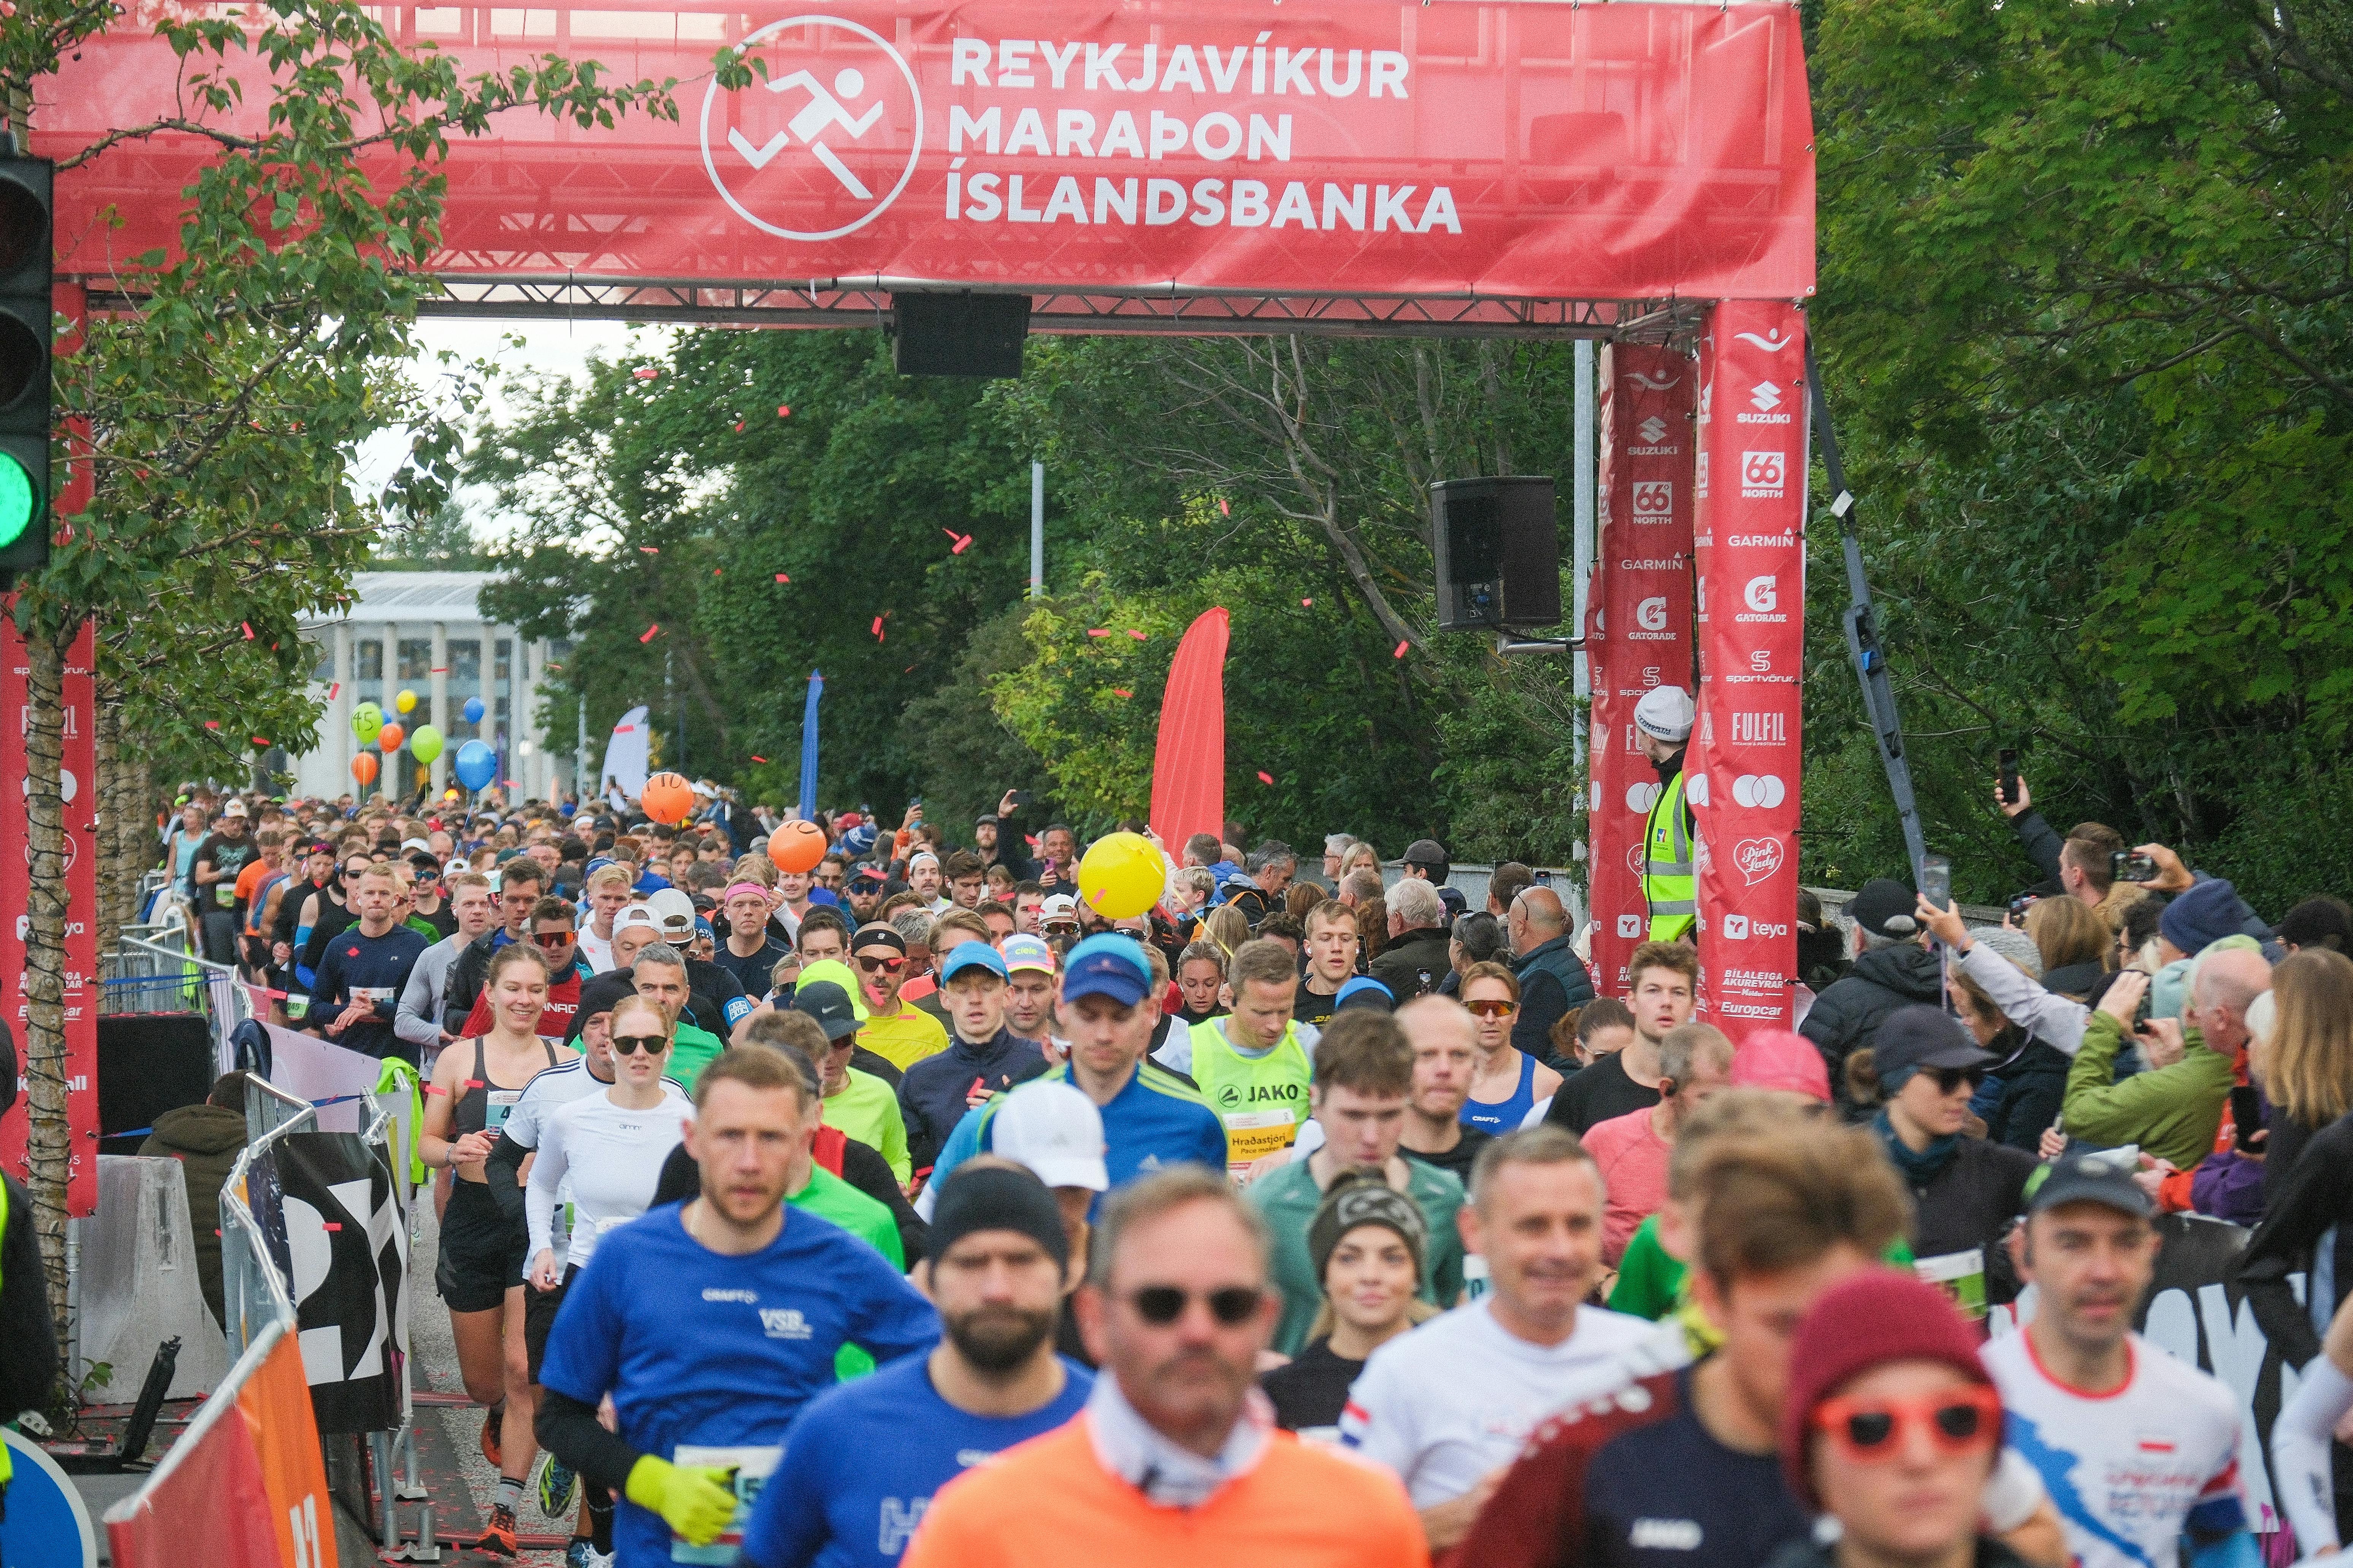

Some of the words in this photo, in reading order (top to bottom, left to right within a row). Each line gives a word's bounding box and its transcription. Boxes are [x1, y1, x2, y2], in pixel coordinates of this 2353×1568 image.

[951, 31, 1409, 99] REYKJAVÍKUR
[948, 105, 1292, 162] MARAÞON
[946, 157, 1462, 234] ÍSLANDSBANKA
[1737, 412, 1791, 424] SUZUKI
[1628, 446, 1678, 455] SUZUKI
[1742, 489, 1784, 498] NORTH
[1728, 535, 1794, 547] GARMIN
[1621, 559, 1683, 570] GARMIN
[1735, 613, 1787, 622] GATORADE
[1628, 632, 1677, 640] GATORADE
[1732, 712, 1786, 741] FULFIL
[1741, 841, 1775, 863] Pink
[1746, 855, 1776, 873] Lady
[1753, 921, 1787, 939] teya
[1724, 968, 1782, 980] BÍLALEIGA
[1722, 978, 1784, 988] AKUREYRAR
[1720, 1001, 1783, 1017] Europcar
[1248, 1083, 1299, 1102] JAKO
[1259, 1145, 1280, 1154] maker
